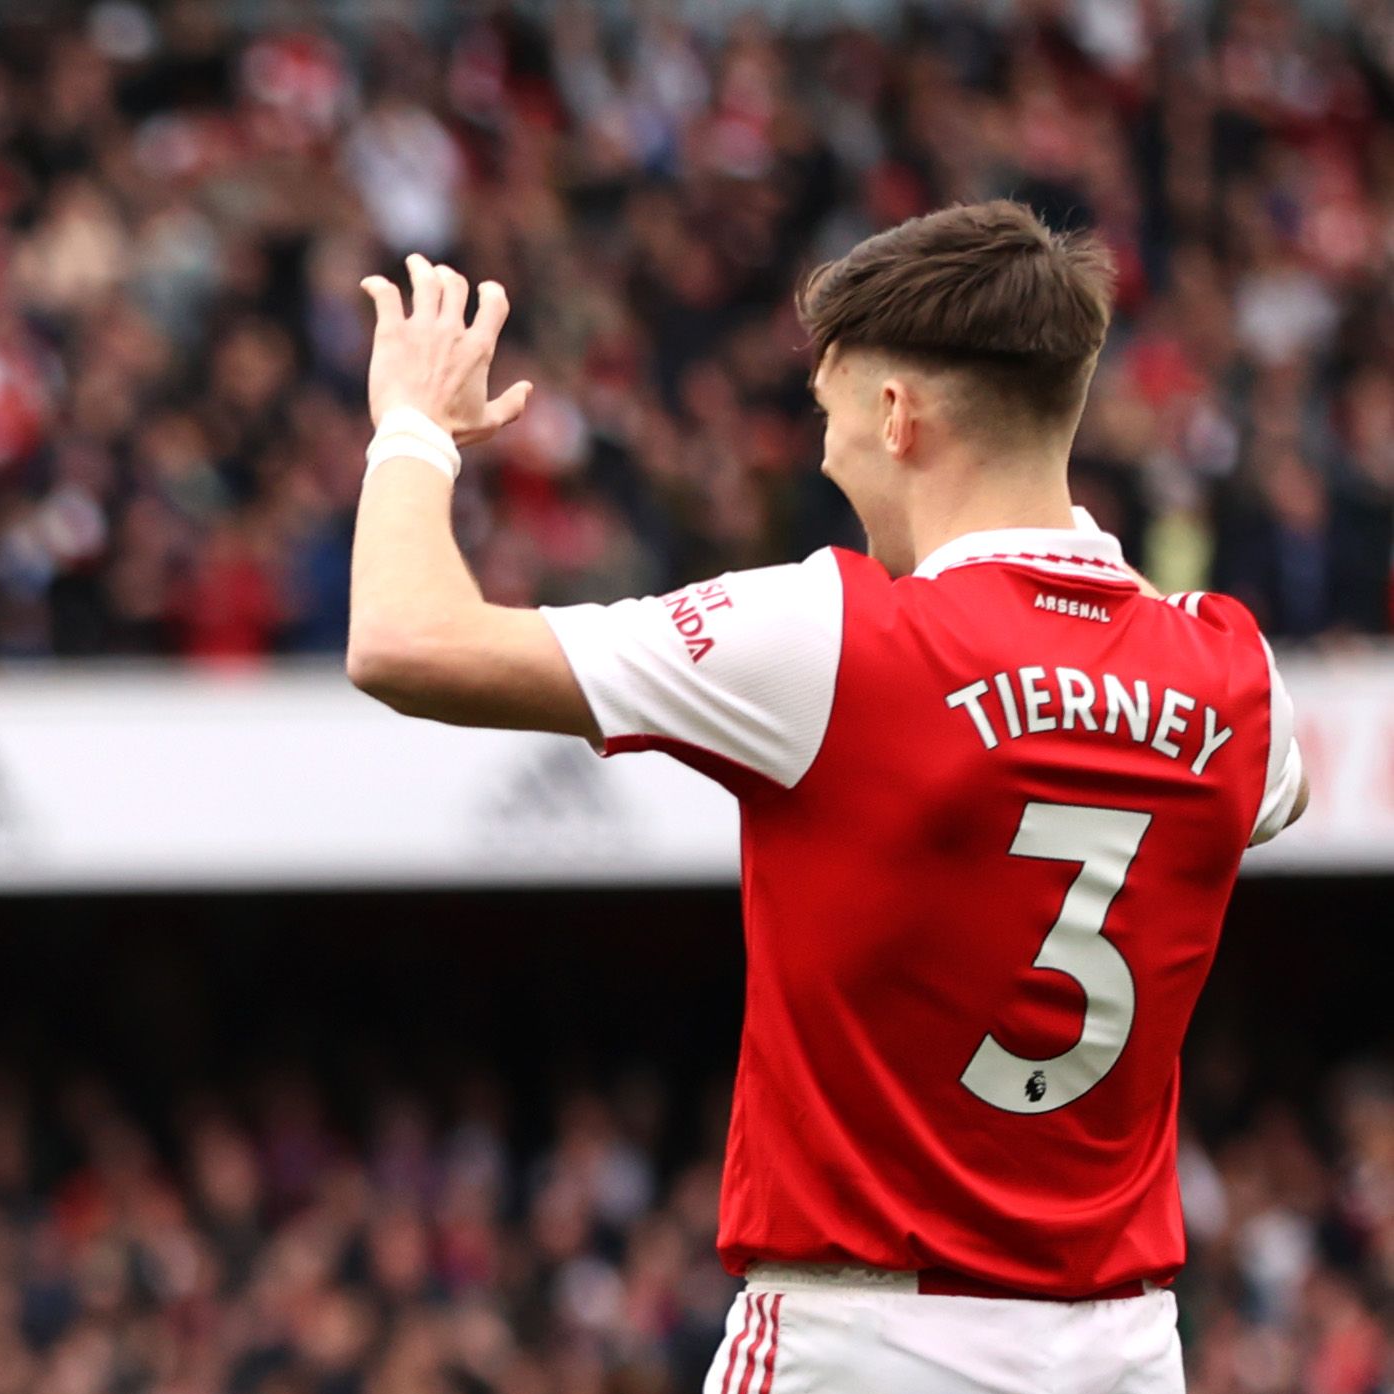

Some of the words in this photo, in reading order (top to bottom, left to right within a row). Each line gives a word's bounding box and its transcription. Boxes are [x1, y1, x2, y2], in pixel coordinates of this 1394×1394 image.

[664, 595, 715, 664] NDA
[696, 583, 734, 611] SIT
[1034, 593, 1111, 622] ARSENAL
[945, 666, 1233, 776] TIERNEY
[959, 801, 1153, 1114] 3
